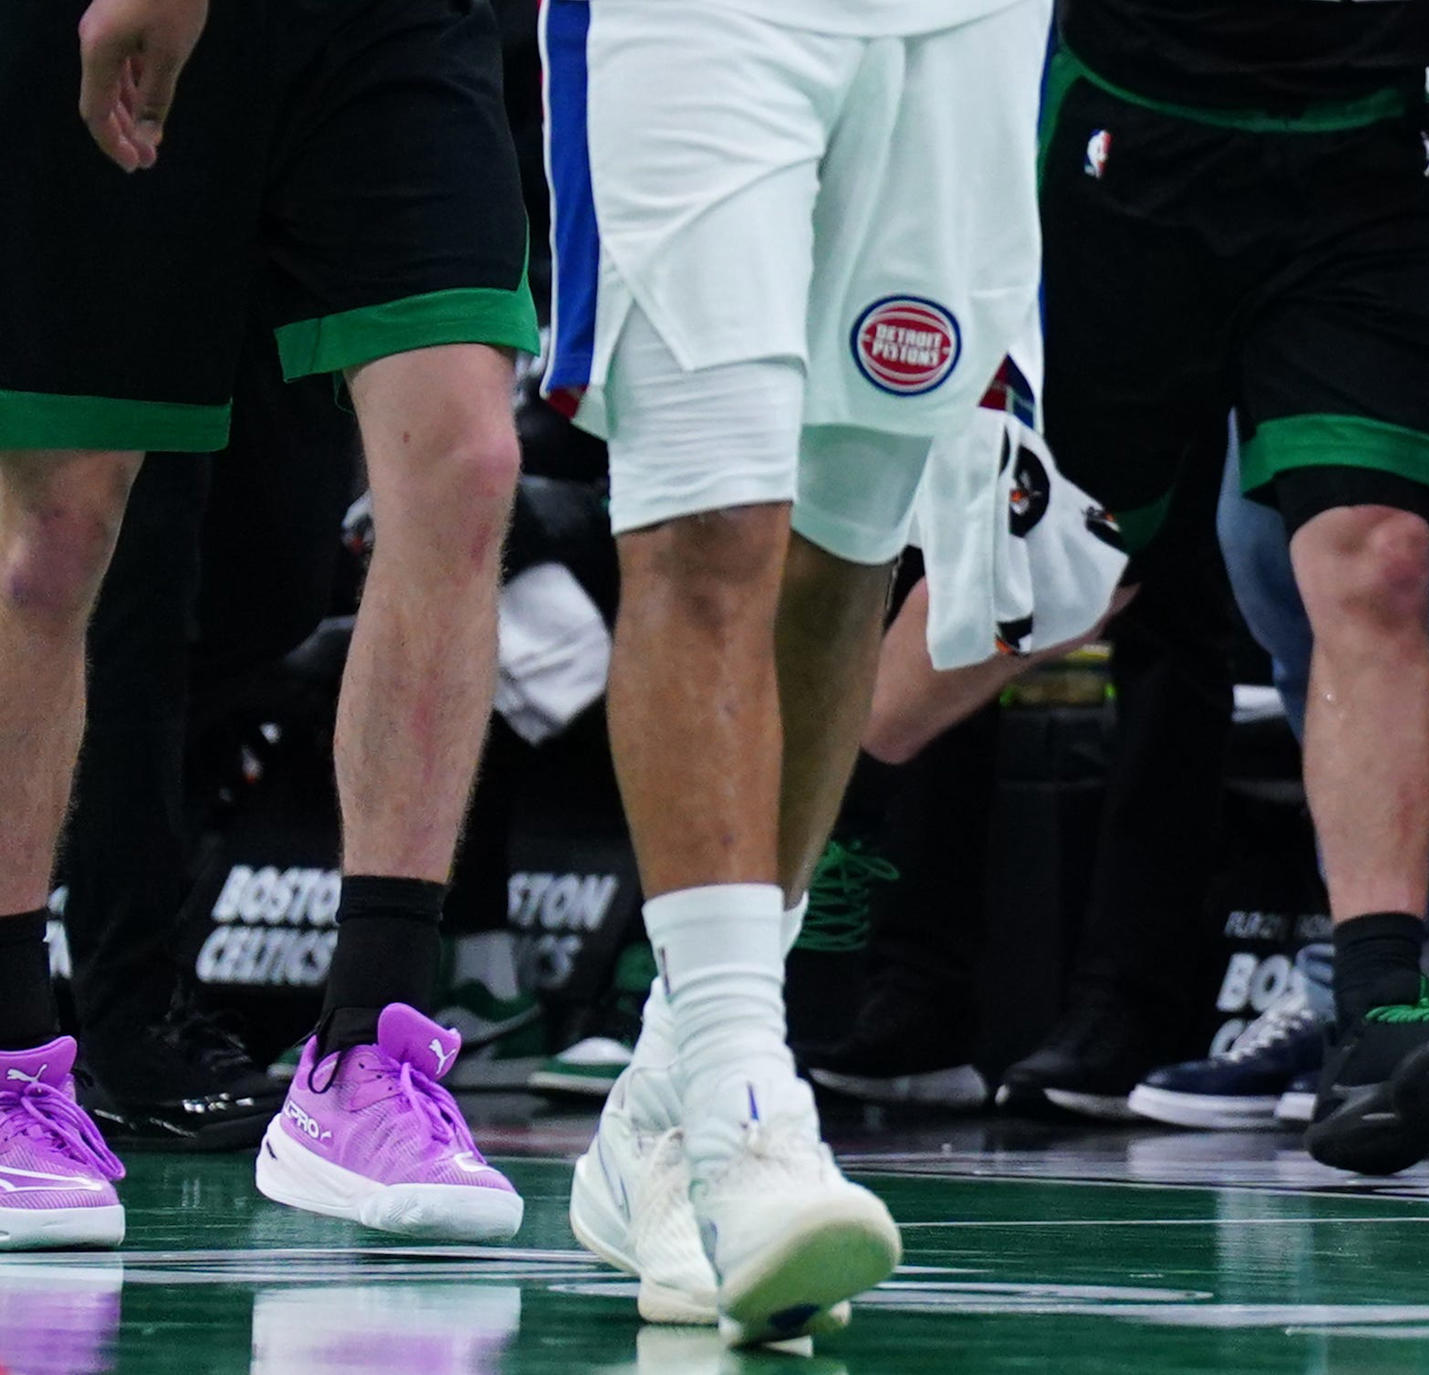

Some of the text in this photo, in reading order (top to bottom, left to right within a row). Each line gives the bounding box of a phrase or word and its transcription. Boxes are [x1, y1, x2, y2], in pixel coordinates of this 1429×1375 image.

[875, 323, 944, 349] DETROIT
[871, 340, 942, 369] PISTONS
[210, 863, 344, 928] BOSTO
